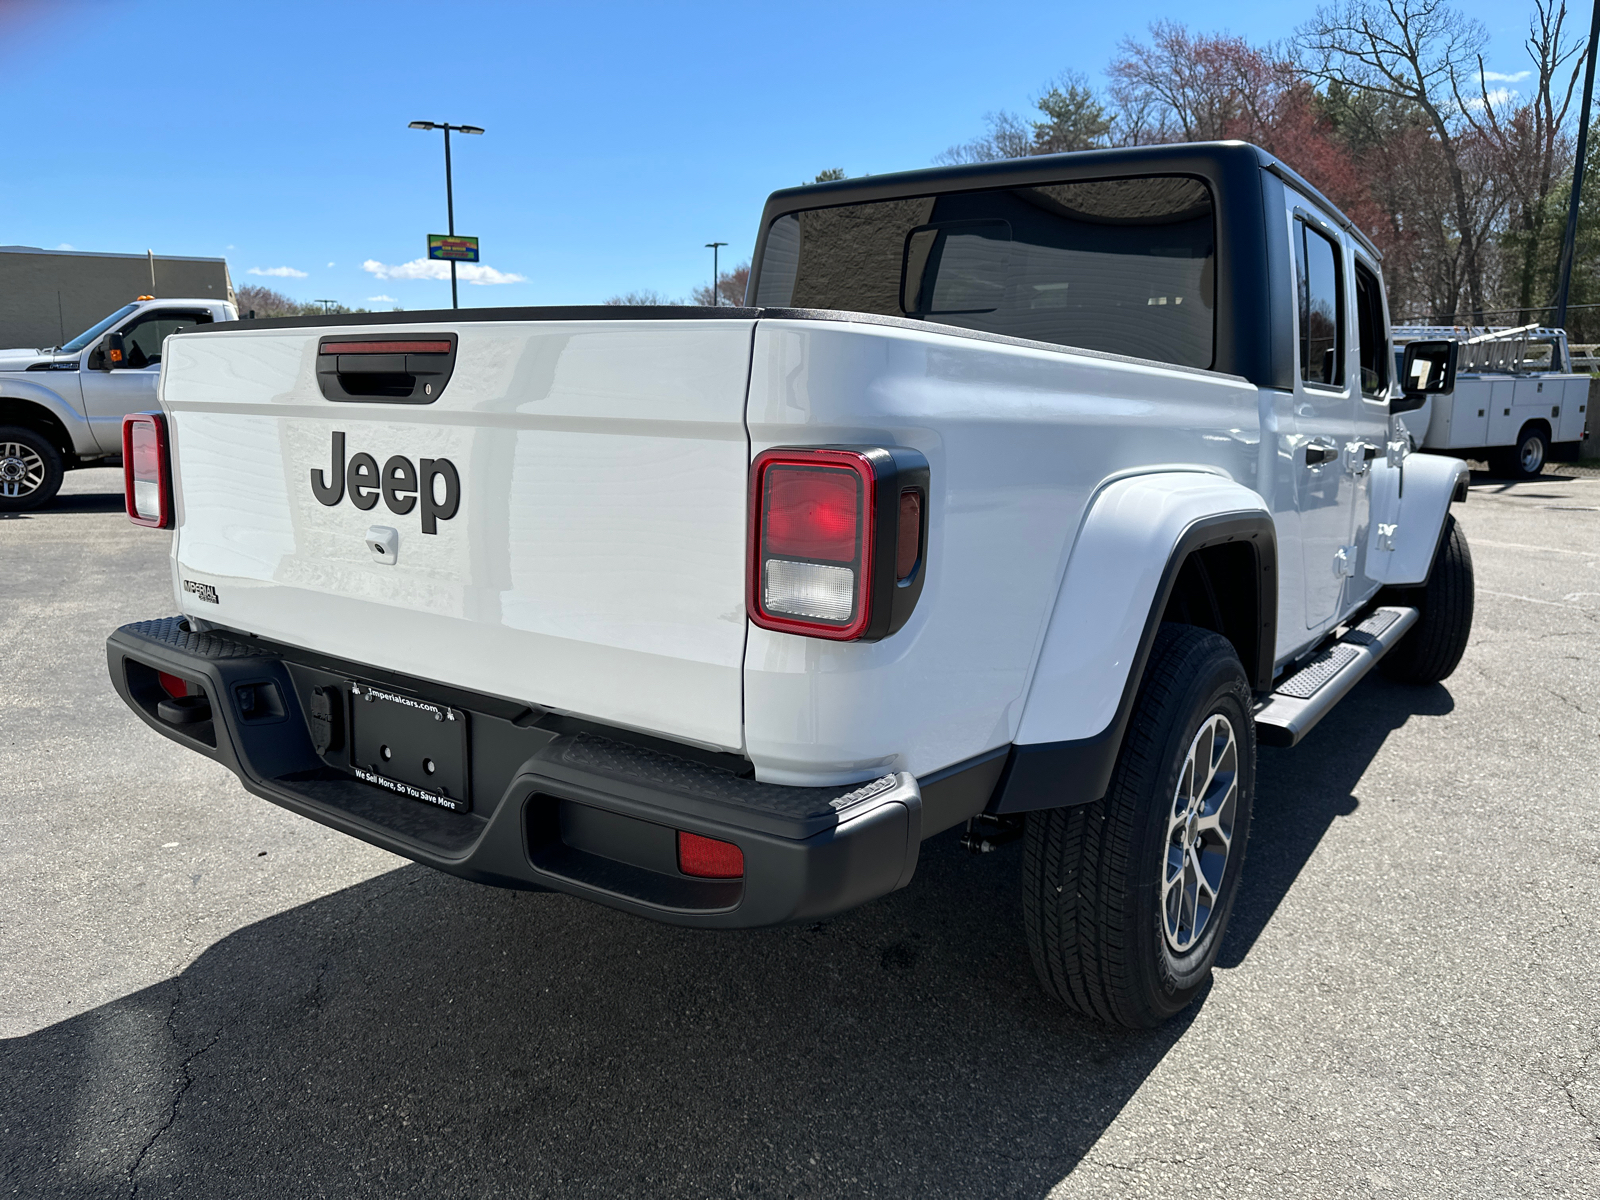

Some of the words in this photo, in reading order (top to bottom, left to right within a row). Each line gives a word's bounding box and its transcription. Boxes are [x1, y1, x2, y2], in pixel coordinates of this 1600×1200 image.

[310, 431, 461, 535] Jeep
[368, 687, 438, 713] Imperialcars.com
[355, 769, 365, 780] We
[366, 773, 377, 783] Sell
[378, 777, 396, 791] More,
[397, 783, 406, 793] So
[406, 786, 419, 798] You
[420, 791, 437, 803] Save
[438, 797, 455, 810] More
